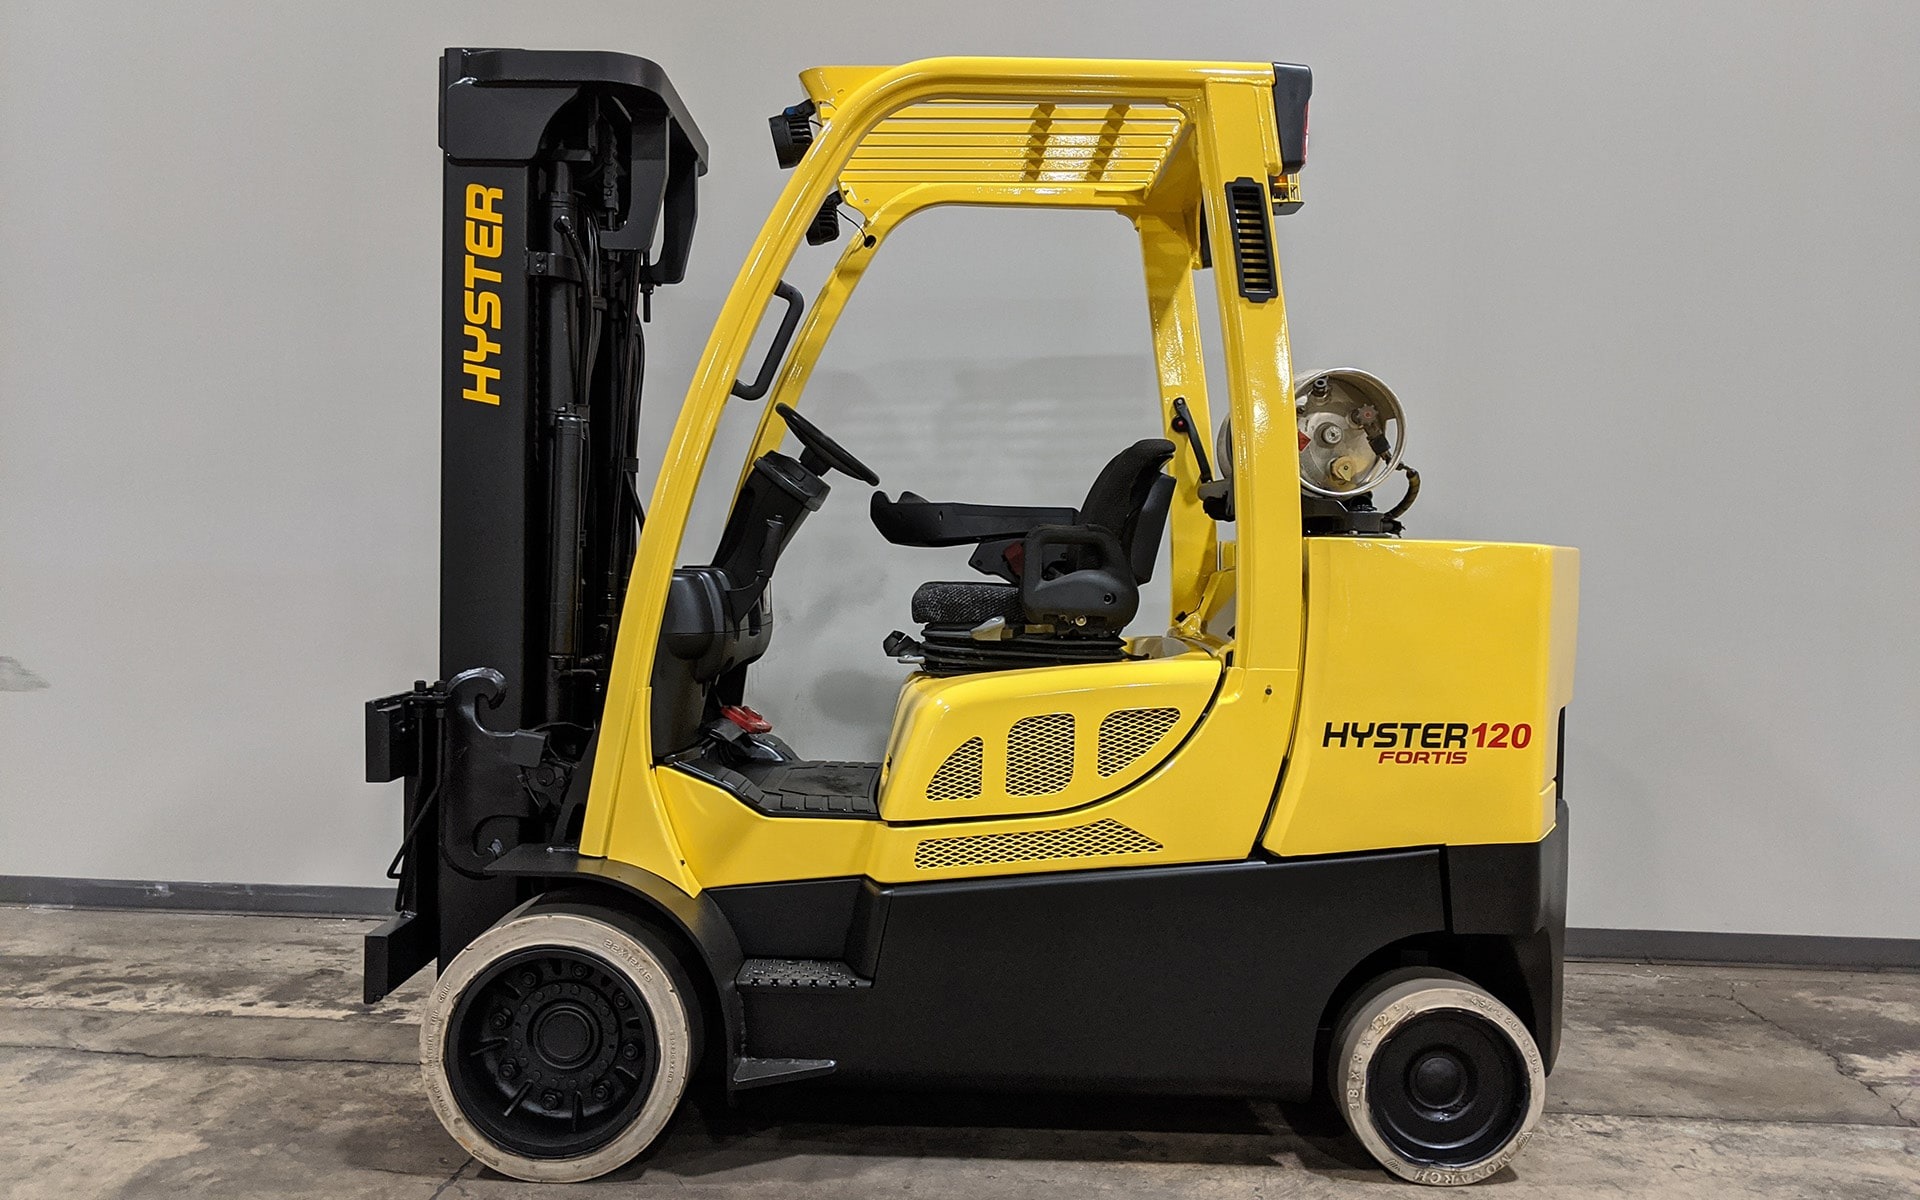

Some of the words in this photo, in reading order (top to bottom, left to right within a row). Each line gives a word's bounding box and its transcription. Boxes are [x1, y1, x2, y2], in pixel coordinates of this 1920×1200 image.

[462, 183, 504, 406] HYSTER
[1322, 722, 1469, 749] HYSTER
[1471, 722, 1532, 749] 120
[1378, 751, 1468, 764] FORTIS
[1347, 1088, 1361, 1111] 18
